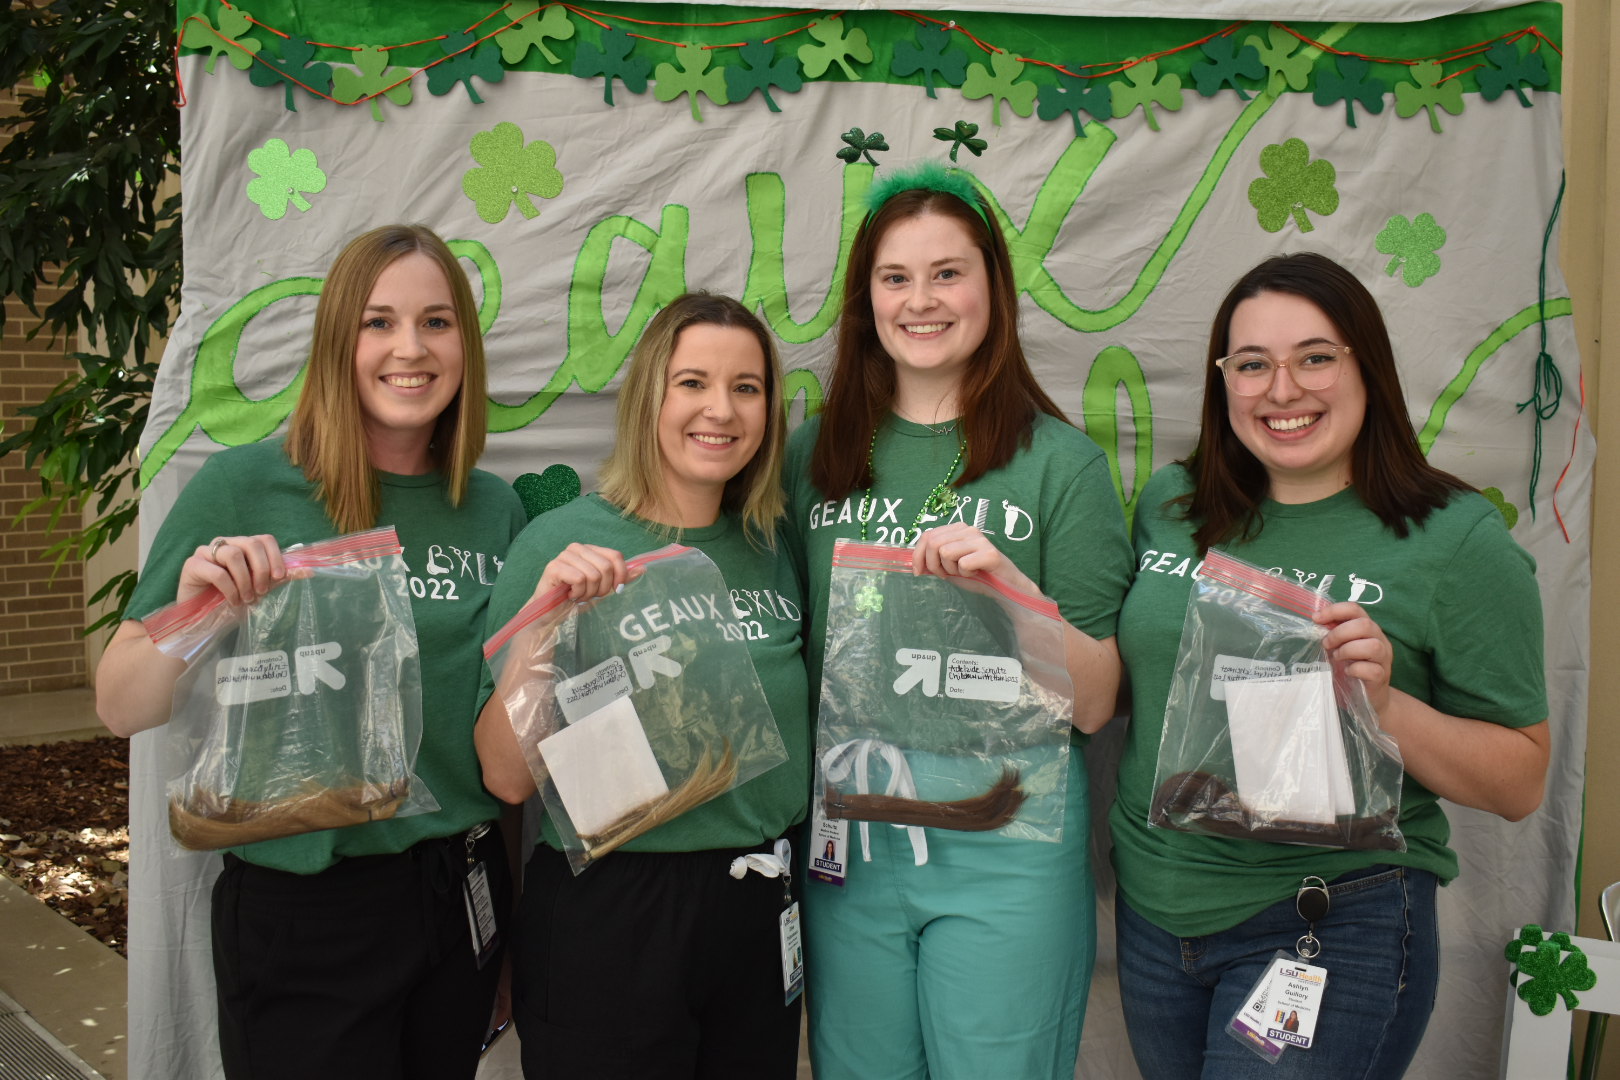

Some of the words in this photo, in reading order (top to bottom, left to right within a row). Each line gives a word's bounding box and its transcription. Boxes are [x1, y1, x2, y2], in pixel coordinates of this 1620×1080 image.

[809, 497, 903, 530] GEAUX
[875, 526, 934, 546] 202
[1140, 550, 1206, 580] GEAU
[395, 574, 460, 600] 2022
[619, 593, 724, 642] GEAUX
[716, 620, 769, 642] 2022
[911, 653, 937, 662] up&up
[952, 657, 979, 666] Contents:
[815, 859, 841, 871] STUDENT
[1280, 967, 1298, 978] LSU
[1285, 989, 1309, 1000] Guillory
[1288, 982, 1309, 991] Ashlyn
[1269, 1029, 1308, 1045] STUDENT
